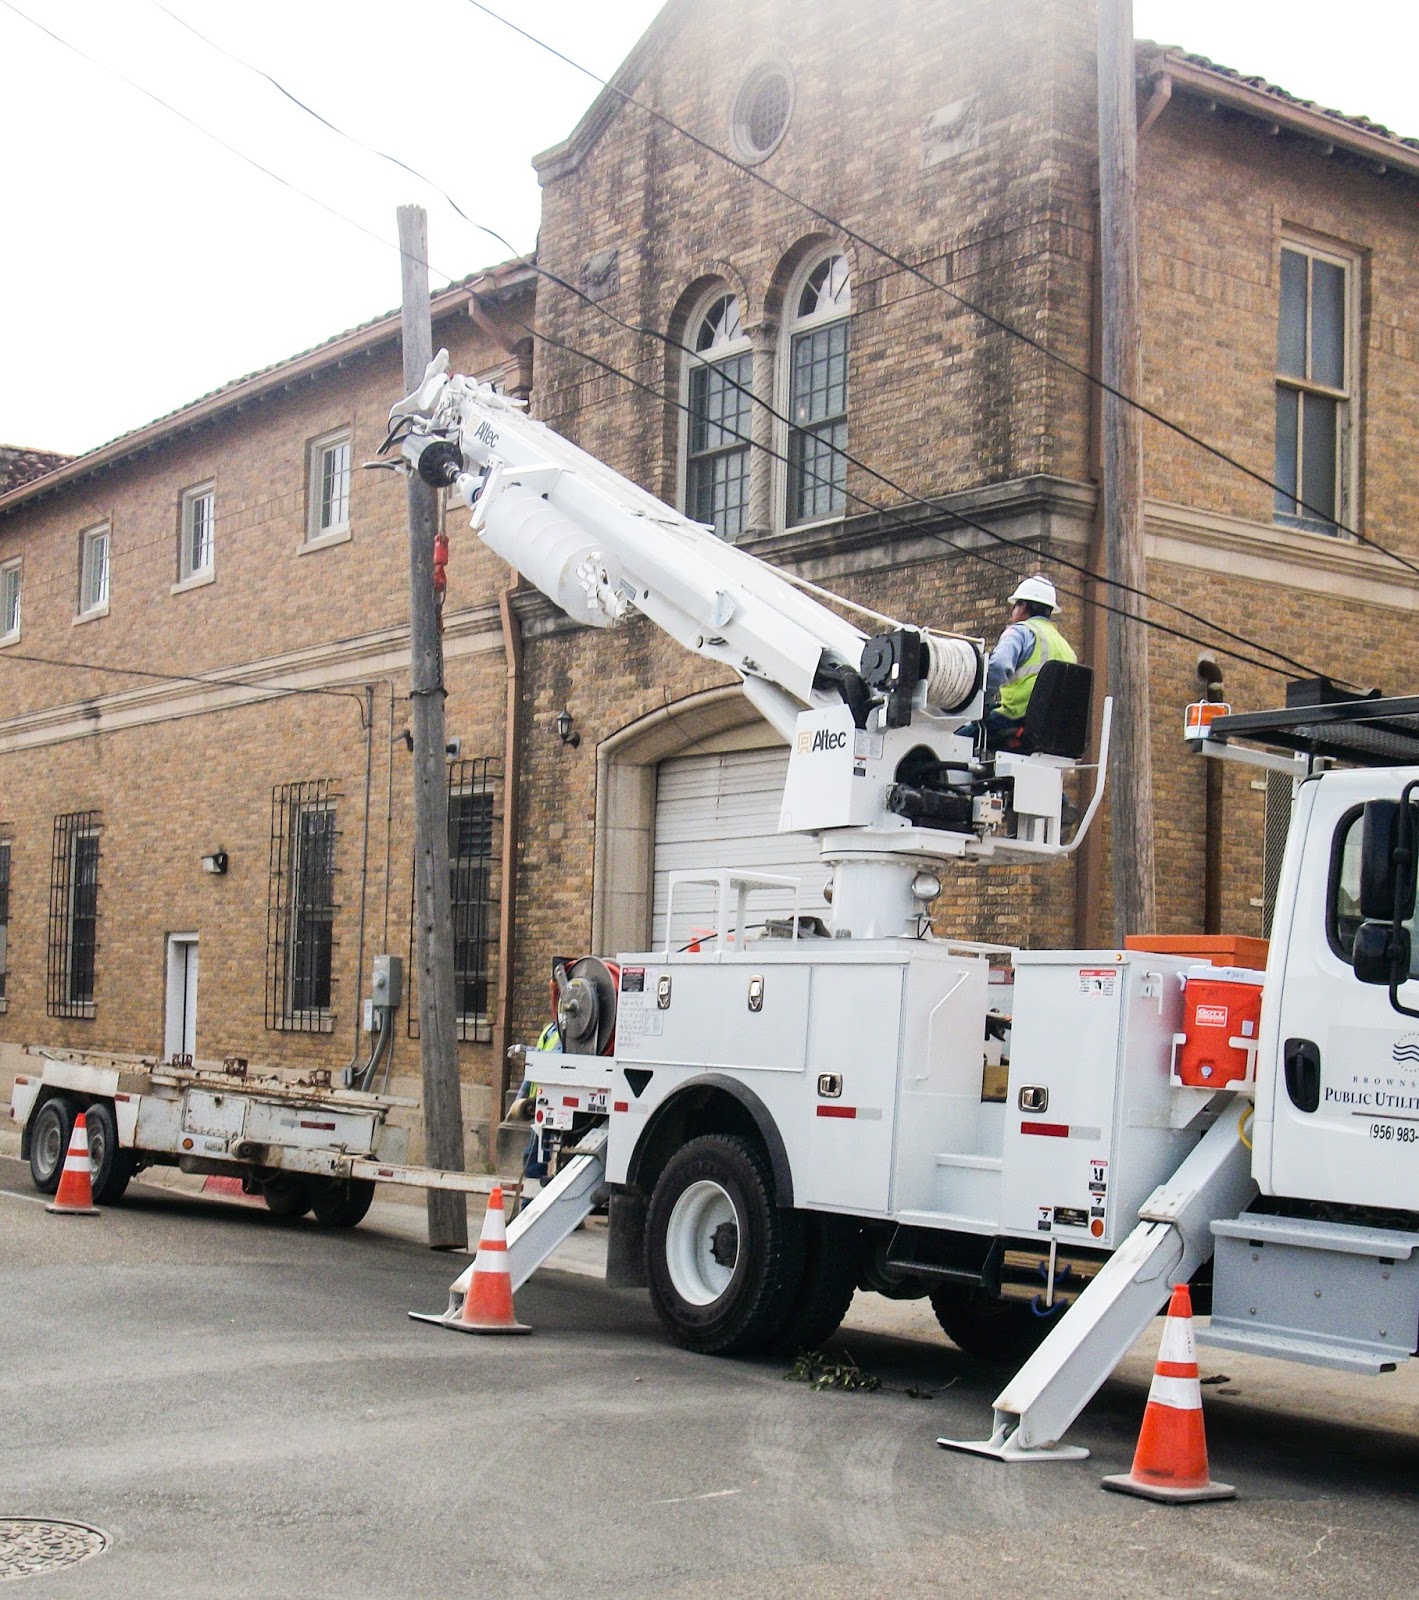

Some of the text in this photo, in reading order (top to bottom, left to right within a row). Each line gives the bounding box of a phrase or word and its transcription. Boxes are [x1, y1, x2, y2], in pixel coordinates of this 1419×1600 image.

[474, 421, 499, 448] Altec
[812, 729, 847, 752] Altec
[1353, 1075, 1416, 1088] BROWNS
[1325, 1087, 1372, 1105] PUBLIC
[1369, 1123, 1395, 1140] (956)
